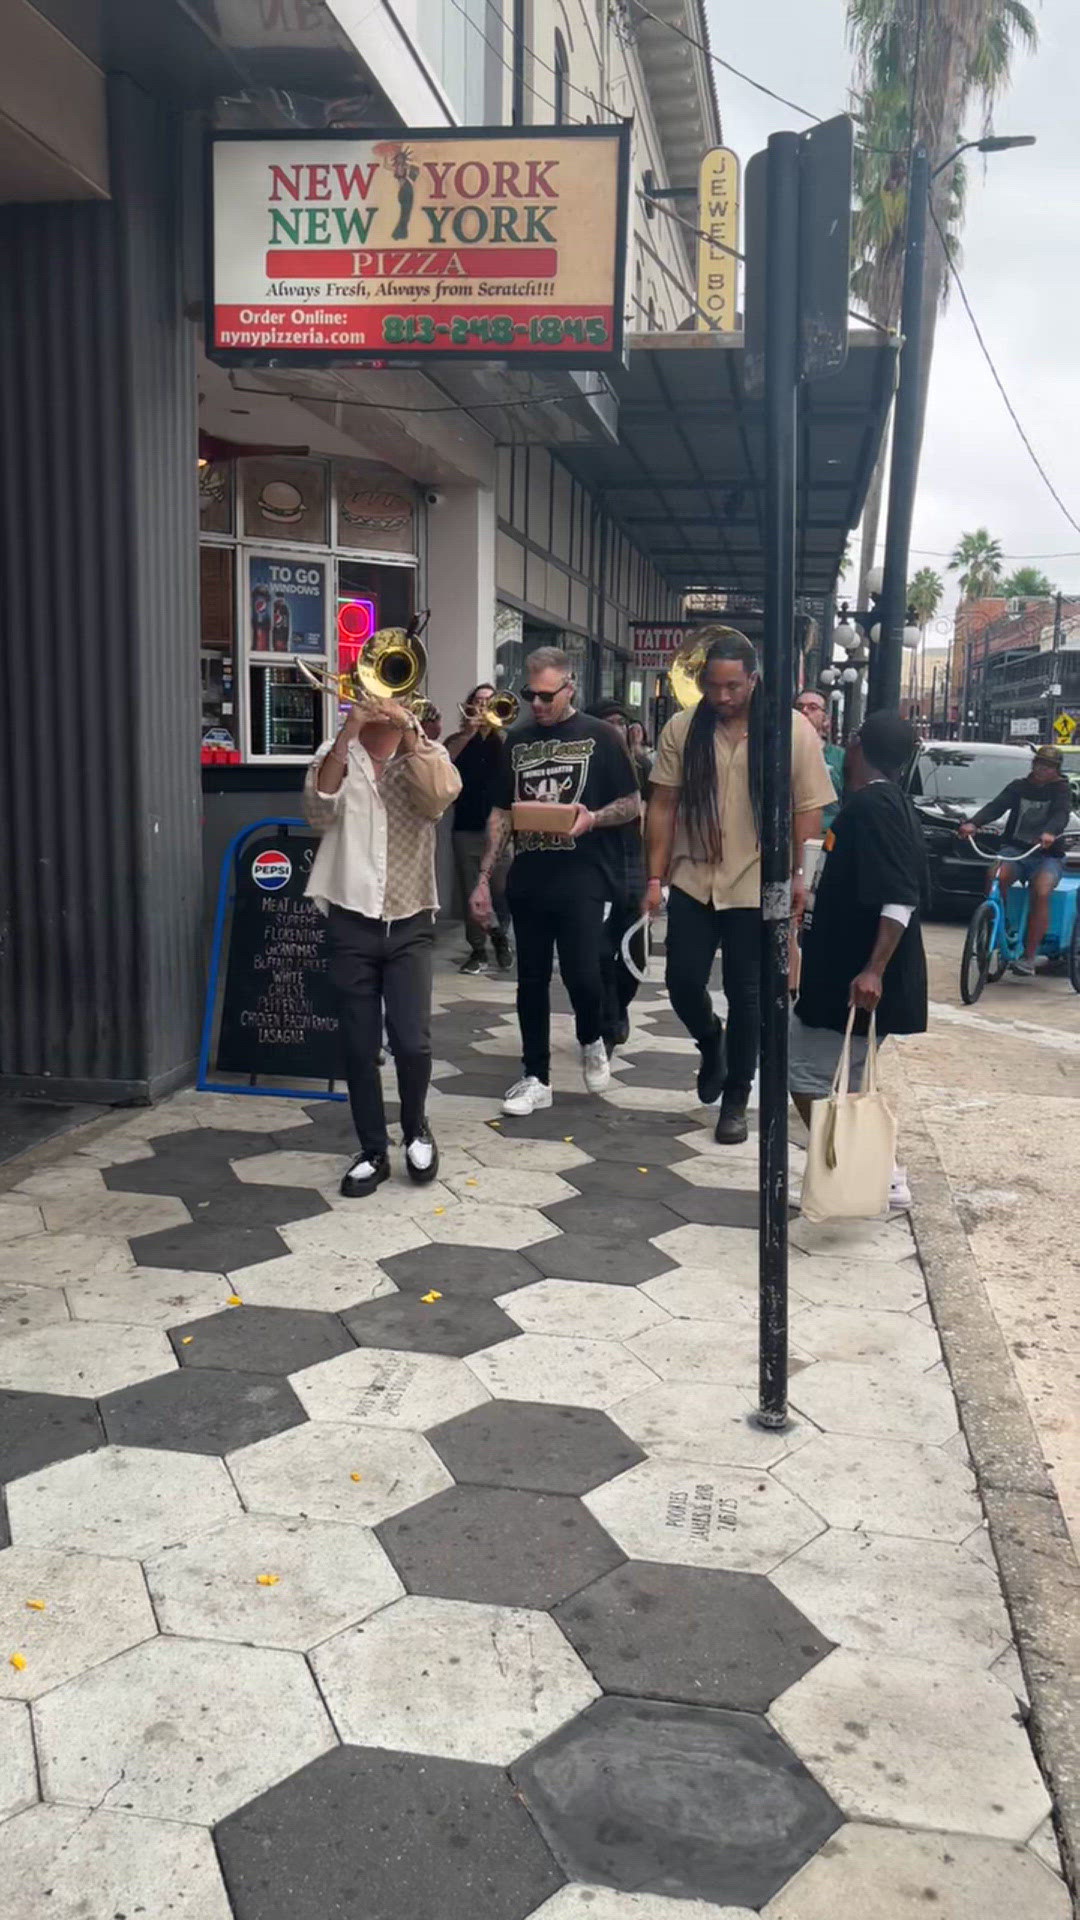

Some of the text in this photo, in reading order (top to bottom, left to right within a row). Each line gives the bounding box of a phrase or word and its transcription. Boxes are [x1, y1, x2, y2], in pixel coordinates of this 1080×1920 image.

[268, 160, 560, 201] NEW YORK
[708, 158, 728, 260] JEWEL
[268, 206, 558, 245] NEW YORK
[351, 252, 468, 277] PIZZA
[266, 281, 555, 300] Always Fresh, Always from Scratch!!!
[239, 309, 348, 326] Order Online:
[220, 327, 366, 347] nynypizzeria.com
[382, 315, 608, 344] 813-248-1845
[269, 565, 320, 585] TO GO
[269, 582, 320, 597] WINDOWS
[254, 865, 290, 875] PEPSI
[261, 897, 290, 913] MEAT
[264, 928, 326, 944] FLORENTINE
[254, 956, 293, 970] BUFFALO
[273, 970, 304, 984] WHITE
[268, 983, 305, 998] CHEESE
[256, 996, 314, 1013] PEPPERONI
[241, 1010, 339, 1032] CHICKEN BACON RANCH
[258, 1028, 305, 1044] LASAGNA
